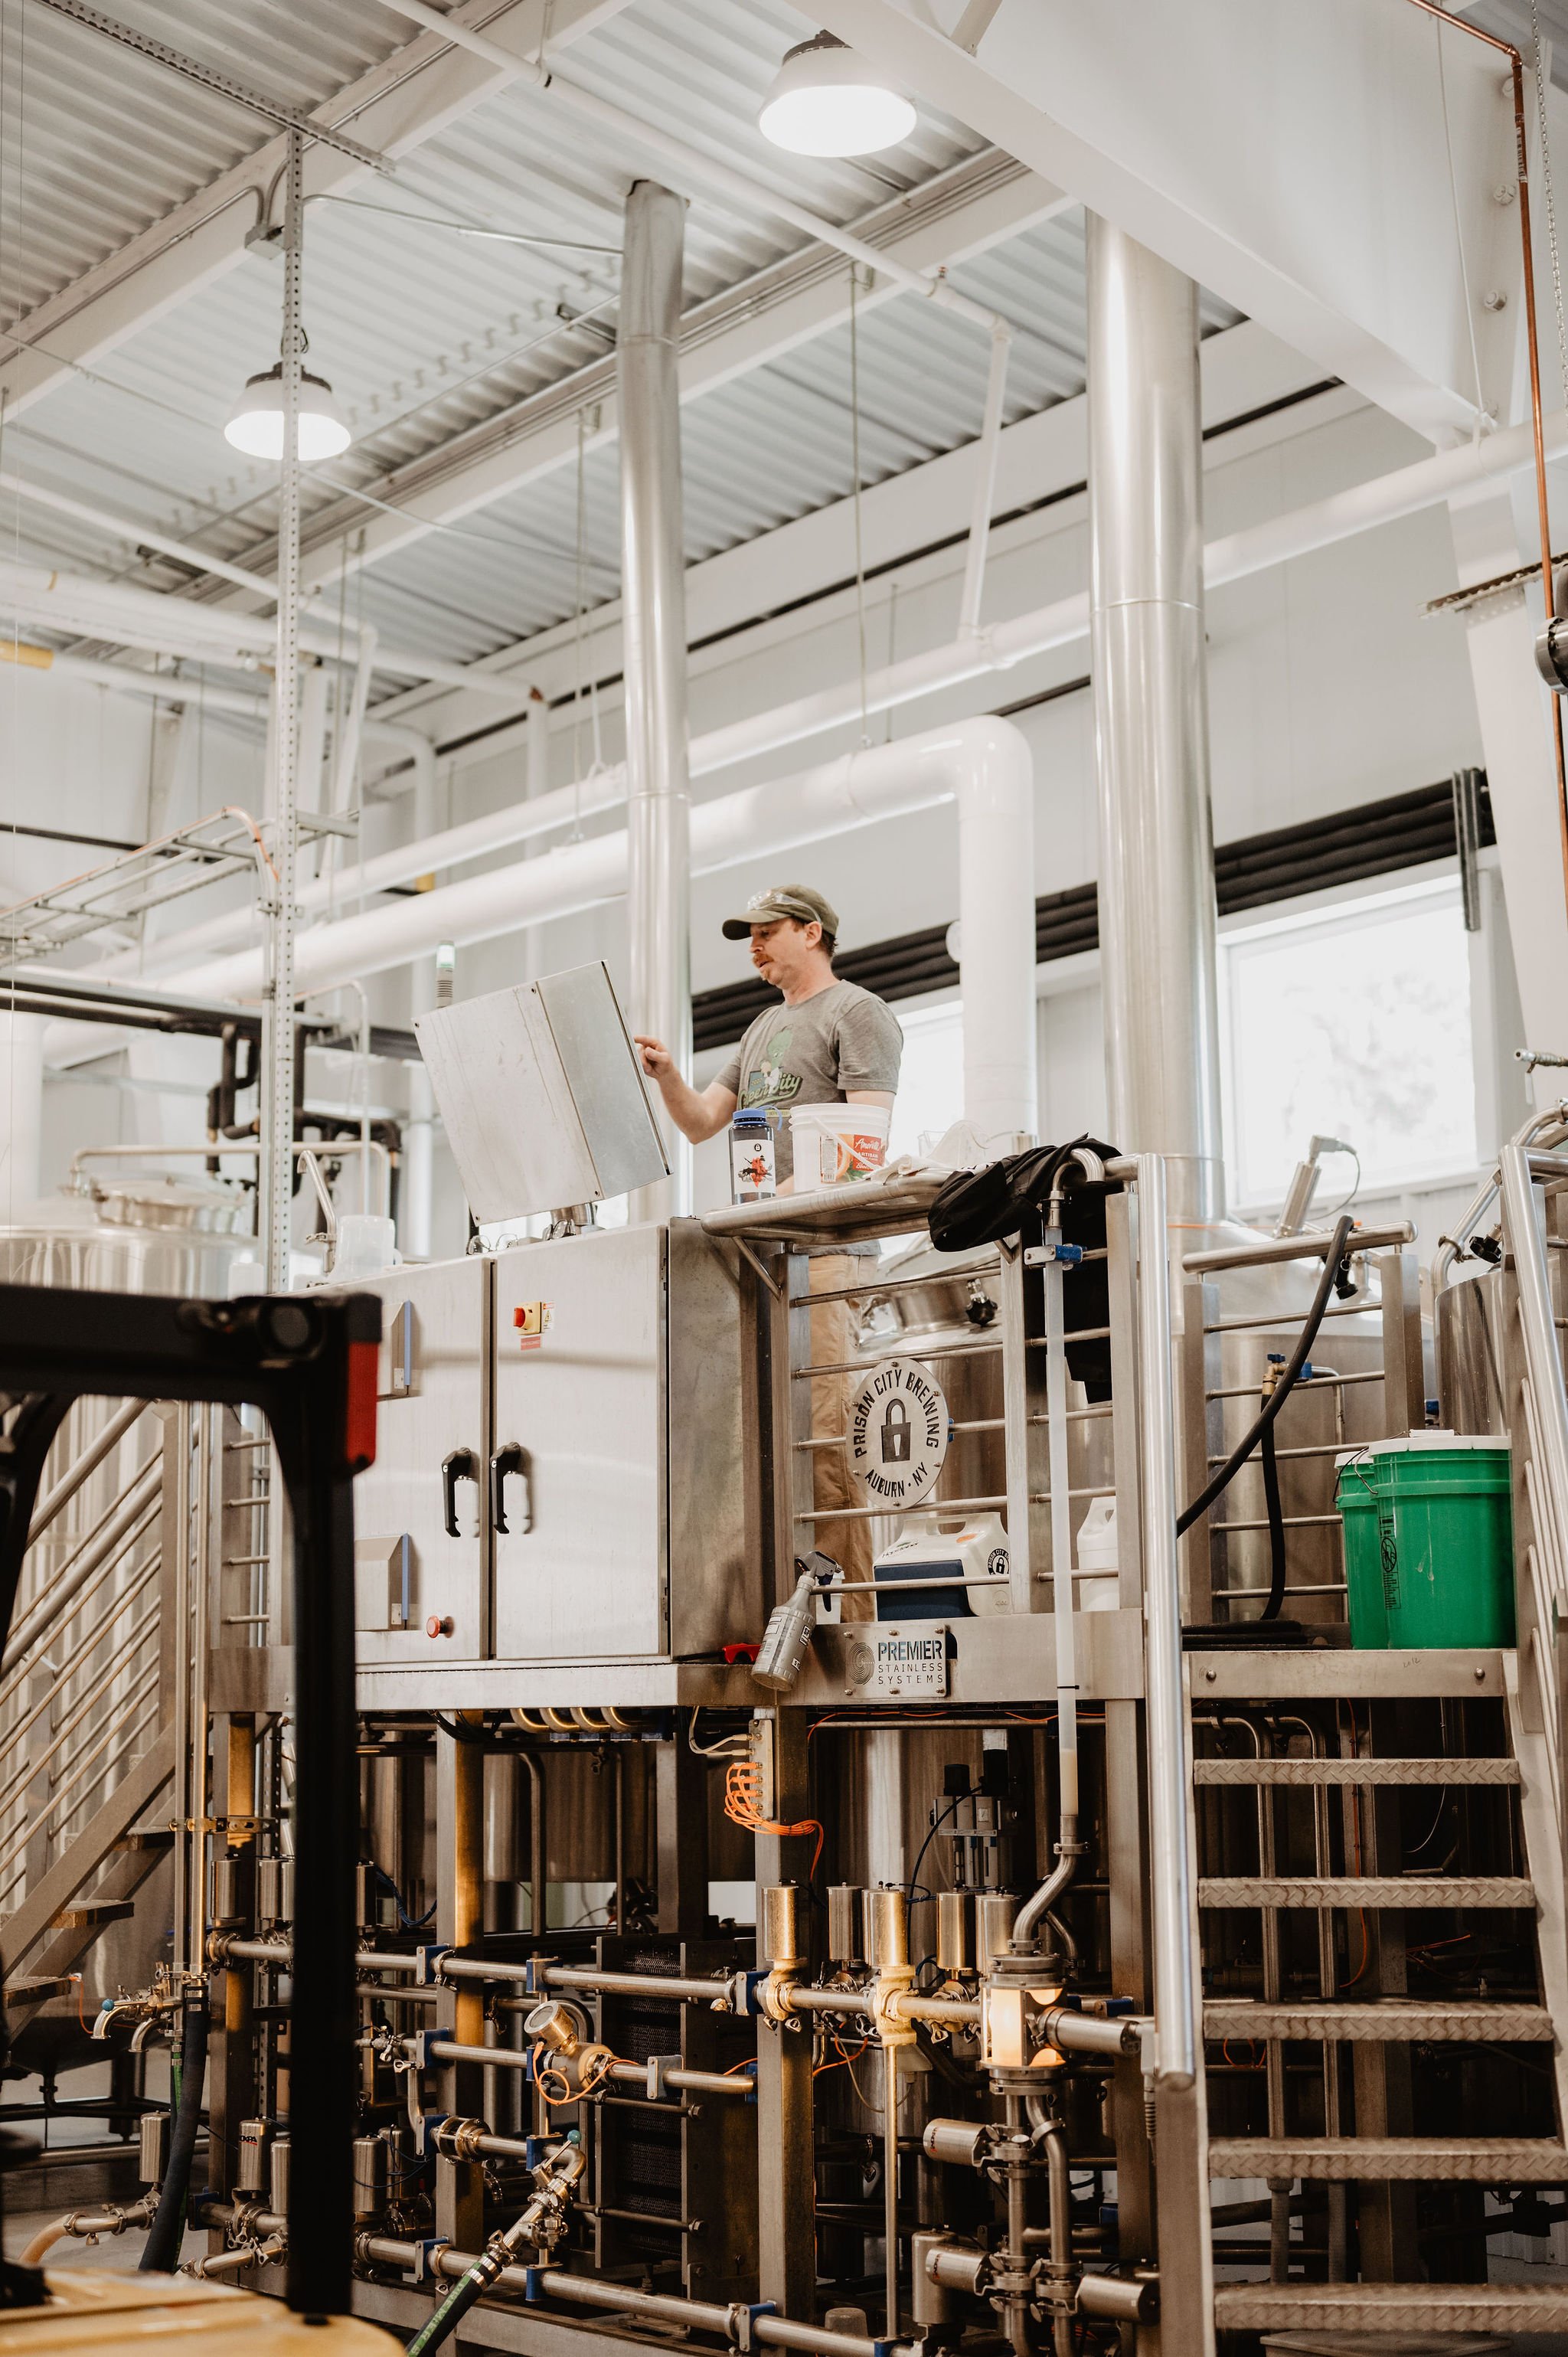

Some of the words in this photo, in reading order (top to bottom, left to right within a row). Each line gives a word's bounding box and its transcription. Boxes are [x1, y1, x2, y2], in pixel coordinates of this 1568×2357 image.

[853, 1390, 875, 1458] PRISON
[874, 1369, 902, 1395] CITY
[905, 1371, 939, 1448] BREWING
[864, 1469, 905, 1497] AUBURN
[912, 1462, 928, 1486] NY
[878, 1639, 942, 1661] PREMIER
[878, 1662, 942, 1673] STAINLESS
[878, 1675, 943, 1685] SYSTEMS
